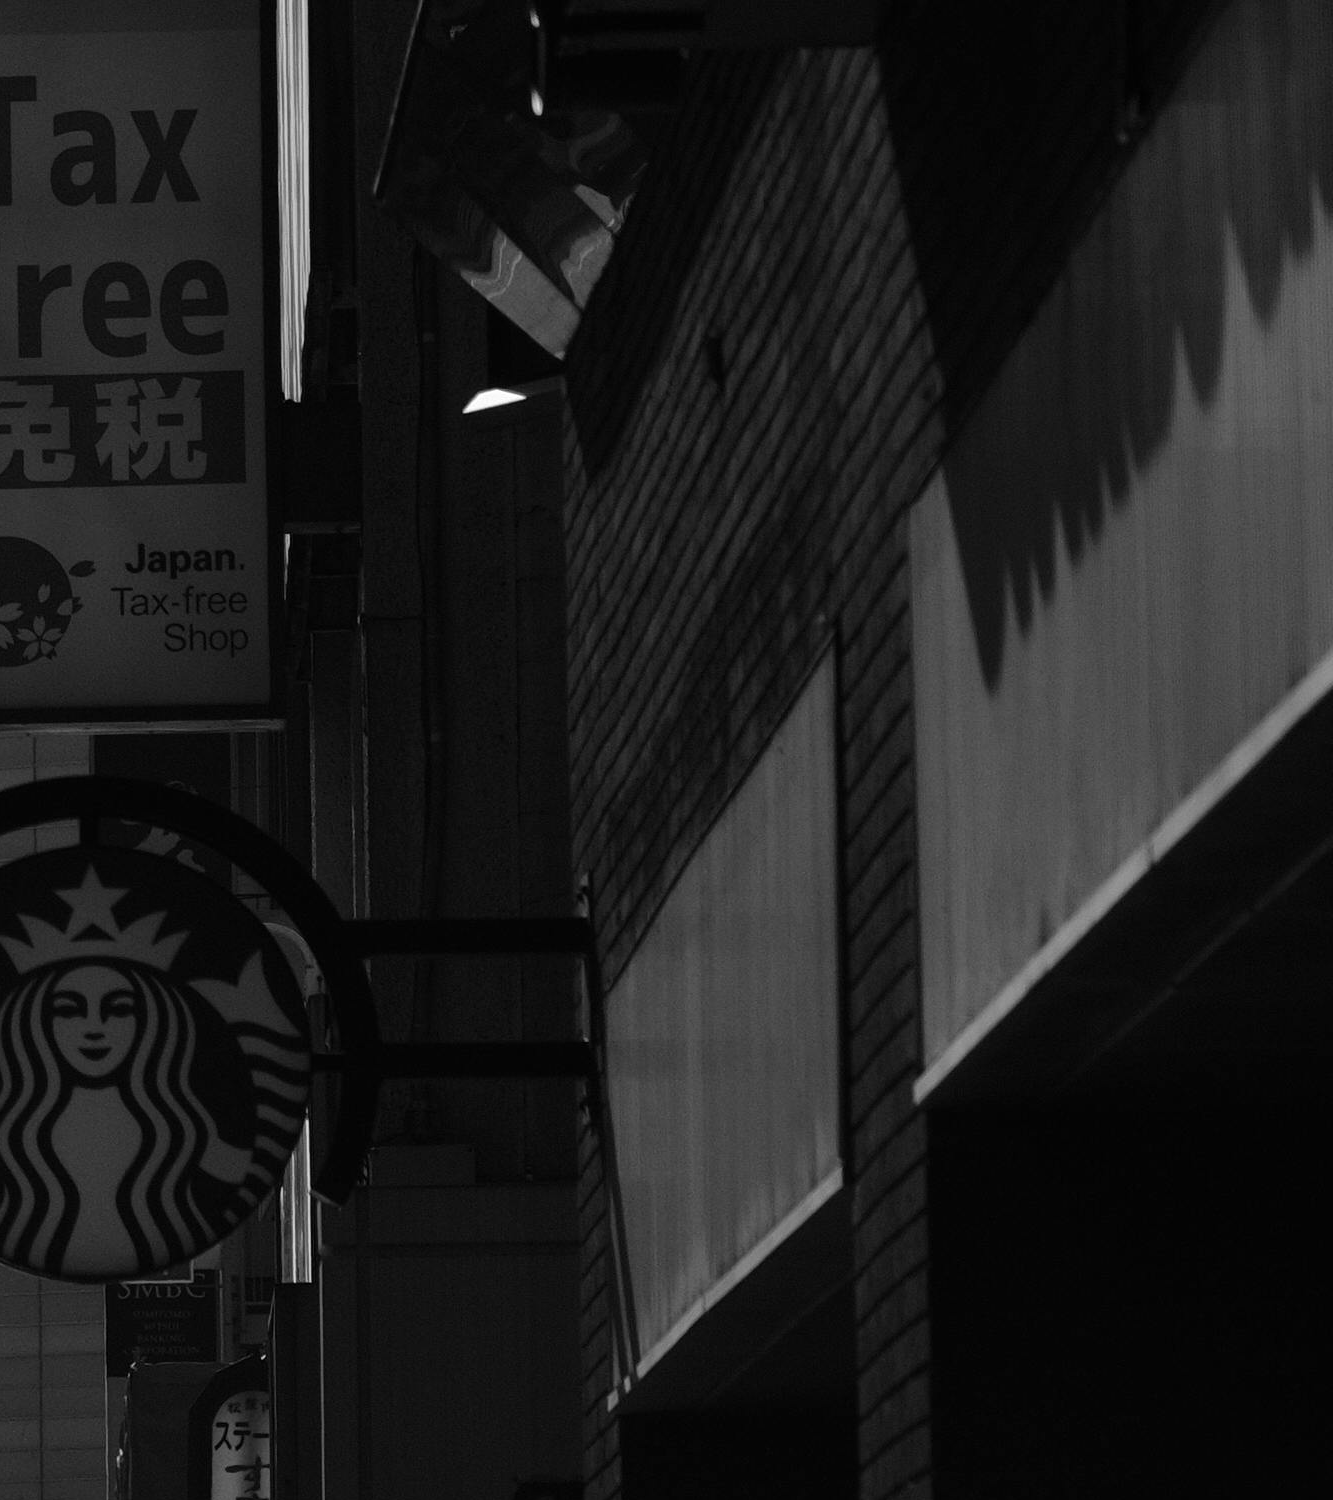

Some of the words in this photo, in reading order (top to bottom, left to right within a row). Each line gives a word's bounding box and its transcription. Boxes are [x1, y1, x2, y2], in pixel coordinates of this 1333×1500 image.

[124, 541, 246, 578] Japan.
[111, 582, 249, 620] Tax-free
[163, 620, 249, 658] Shop
[215, 1422, 270, 1451] ステー
